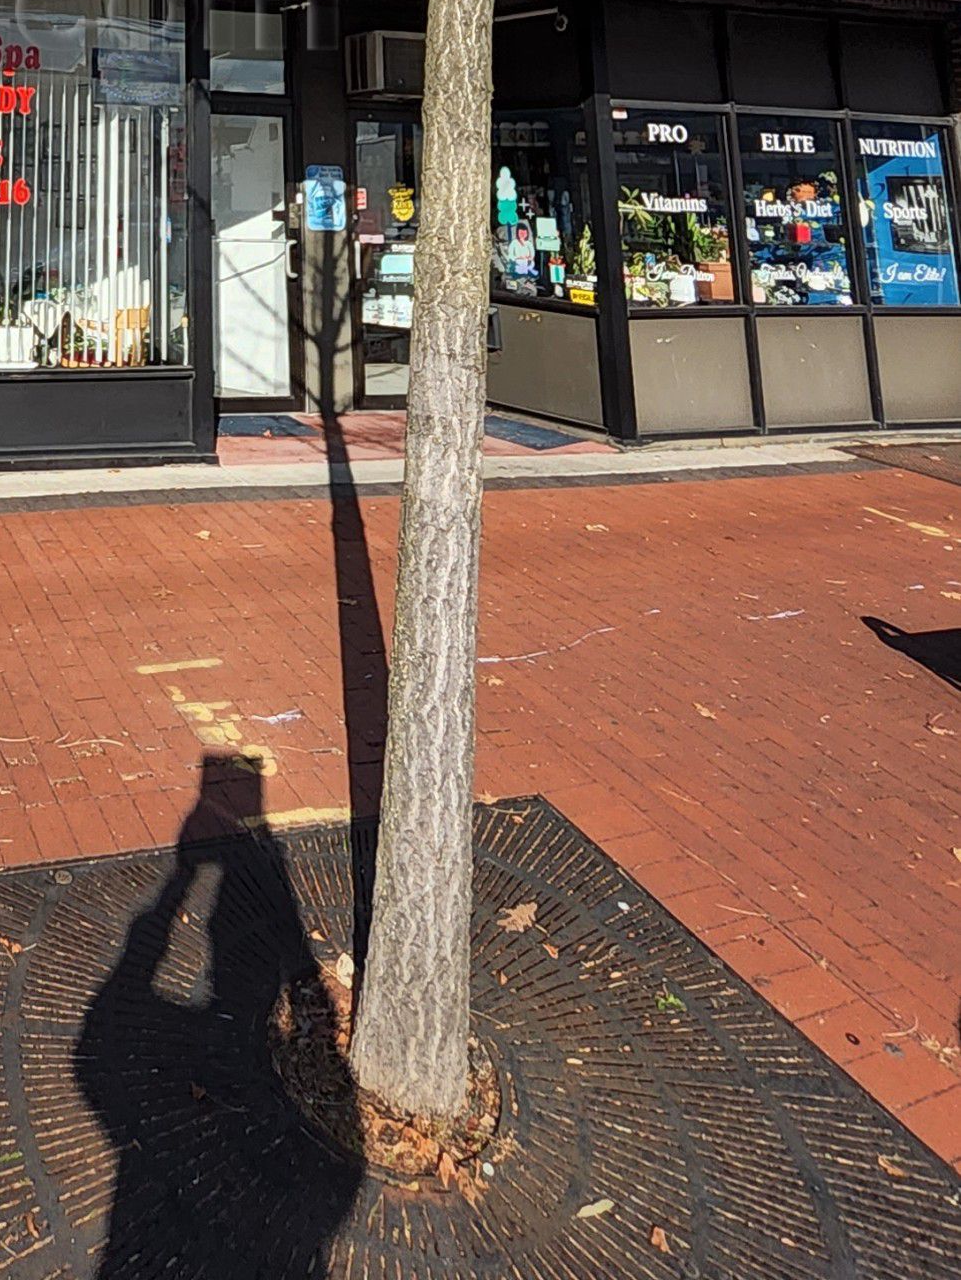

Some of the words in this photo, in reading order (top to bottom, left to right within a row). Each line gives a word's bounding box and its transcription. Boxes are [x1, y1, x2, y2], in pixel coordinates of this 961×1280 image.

[647, 123, 688, 143] PRO
[760, 132, 816, 153] ELITE
[858, 137, 936, 158] NUTRITION
[640, 187, 708, 212] Vitamins
[805, 199, 834, 217] Diet
[882, 202, 928, 223] Sports
